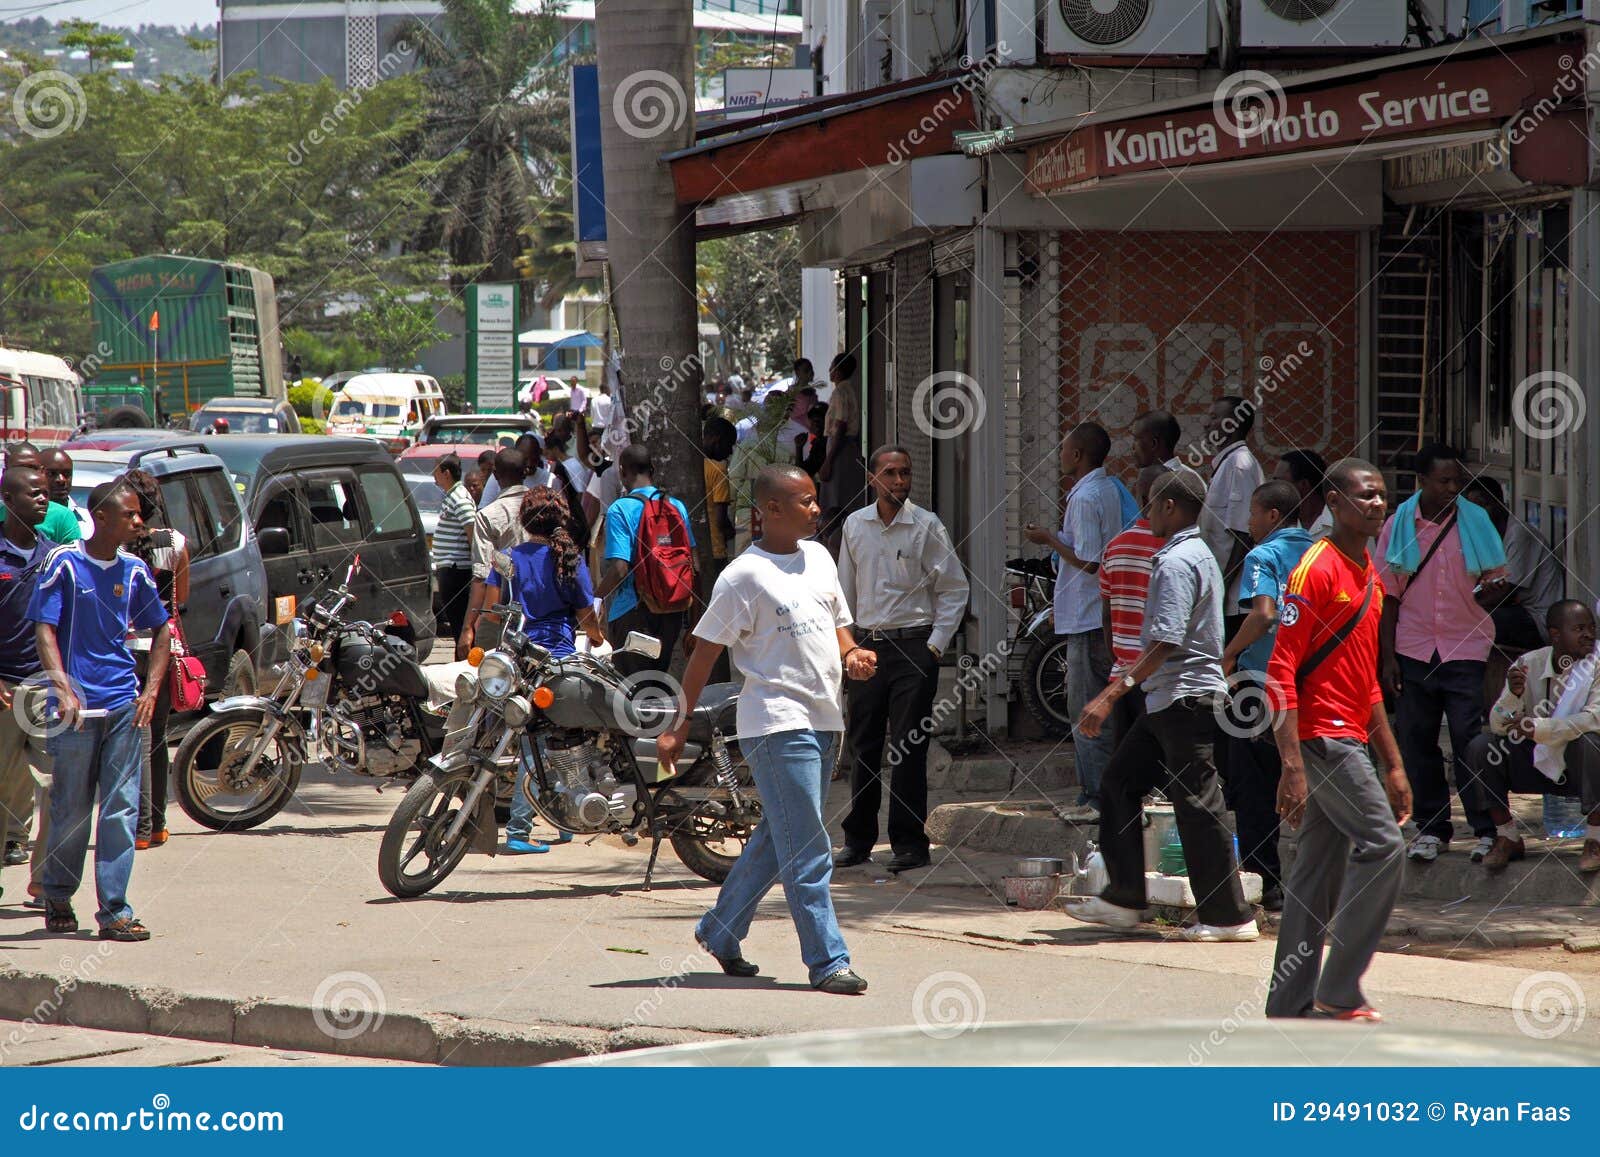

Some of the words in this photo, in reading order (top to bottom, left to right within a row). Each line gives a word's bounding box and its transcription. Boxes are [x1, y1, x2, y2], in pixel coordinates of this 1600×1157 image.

[728, 94, 758, 106] NMB
[1104, 120, 1218, 168] Konica
[1234, 100, 1340, 150] Photo
[1359, 81, 1491, 132] Service
